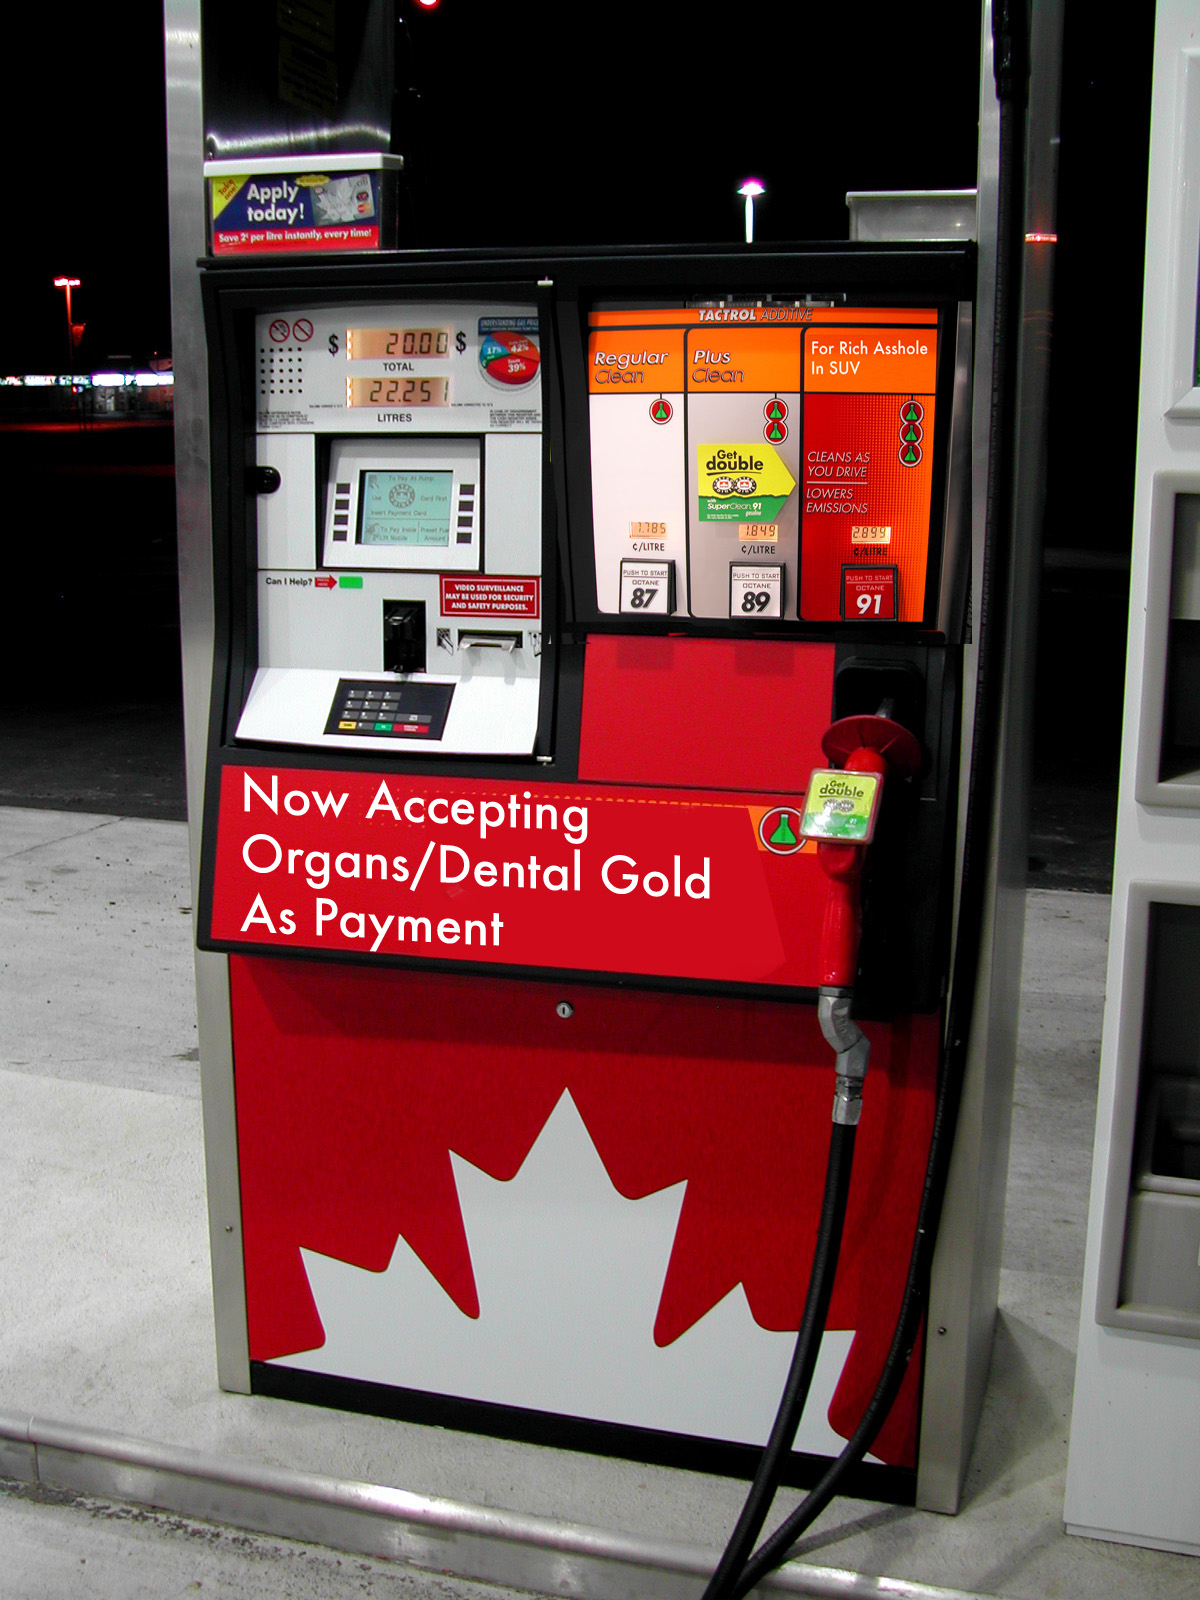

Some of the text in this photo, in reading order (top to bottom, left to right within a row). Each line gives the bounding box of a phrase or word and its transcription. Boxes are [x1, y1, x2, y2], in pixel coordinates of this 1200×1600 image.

[247, 181, 299, 204] Apply
[247, 203, 304, 225] today!
[219, 232, 239, 242] Save
[250, 234, 264, 244] per
[266, 230, 283, 240] litre
[285, 230, 322, 241] instantly,
[324, 231, 349, 240] every
[350, 228, 372, 238] time!
[699, 308, 813, 322] TACTROL ADDITIVE
[328, 330, 467, 356] $ 20.00 $
[511, 344, 529, 354] 42%
[811, 340, 928, 355] For Rich Asshole
[594, 350, 669, 370] Regular
[693, 350, 731, 365] Plus
[383, 362, 415, 372] TOTAL
[508, 362, 526, 373] 39%
[811, 361, 861, 376] In SUV
[595, 369, 645, 384] Clean
[692, 368, 745, 383] Clean
[377, 413, 413, 423] LITRES
[716, 449, 738, 460] Get
[807, 451, 870, 464] CLEANS AS
[706, 455, 764, 471] double
[808, 466, 868, 478] YOU DRIVE
[806, 488, 853, 500] LOWERS
[707, 502, 762, 511] SuperClean 91
[806, 502, 868, 514] EMISSIONS
[265, 577, 282, 585] Can
[289, 578, 313, 587] Help?
[454, 584, 524, 592] VIDEO SURVEILLANCE
[504, 594, 534, 602] SECURITY
[630, 587, 659, 609] 87
[741, 591, 771, 613] 89
[856, 594, 882, 615] 91
[468, 602, 491, 610] SAFETY
[820, 784, 864, 798] double
[830, 780, 846, 788] Get
[244, 771, 588, 844] Now Accepting
[242, 834, 710, 900] Organs/Dental Gold
[240, 892, 504, 952] As Payment
